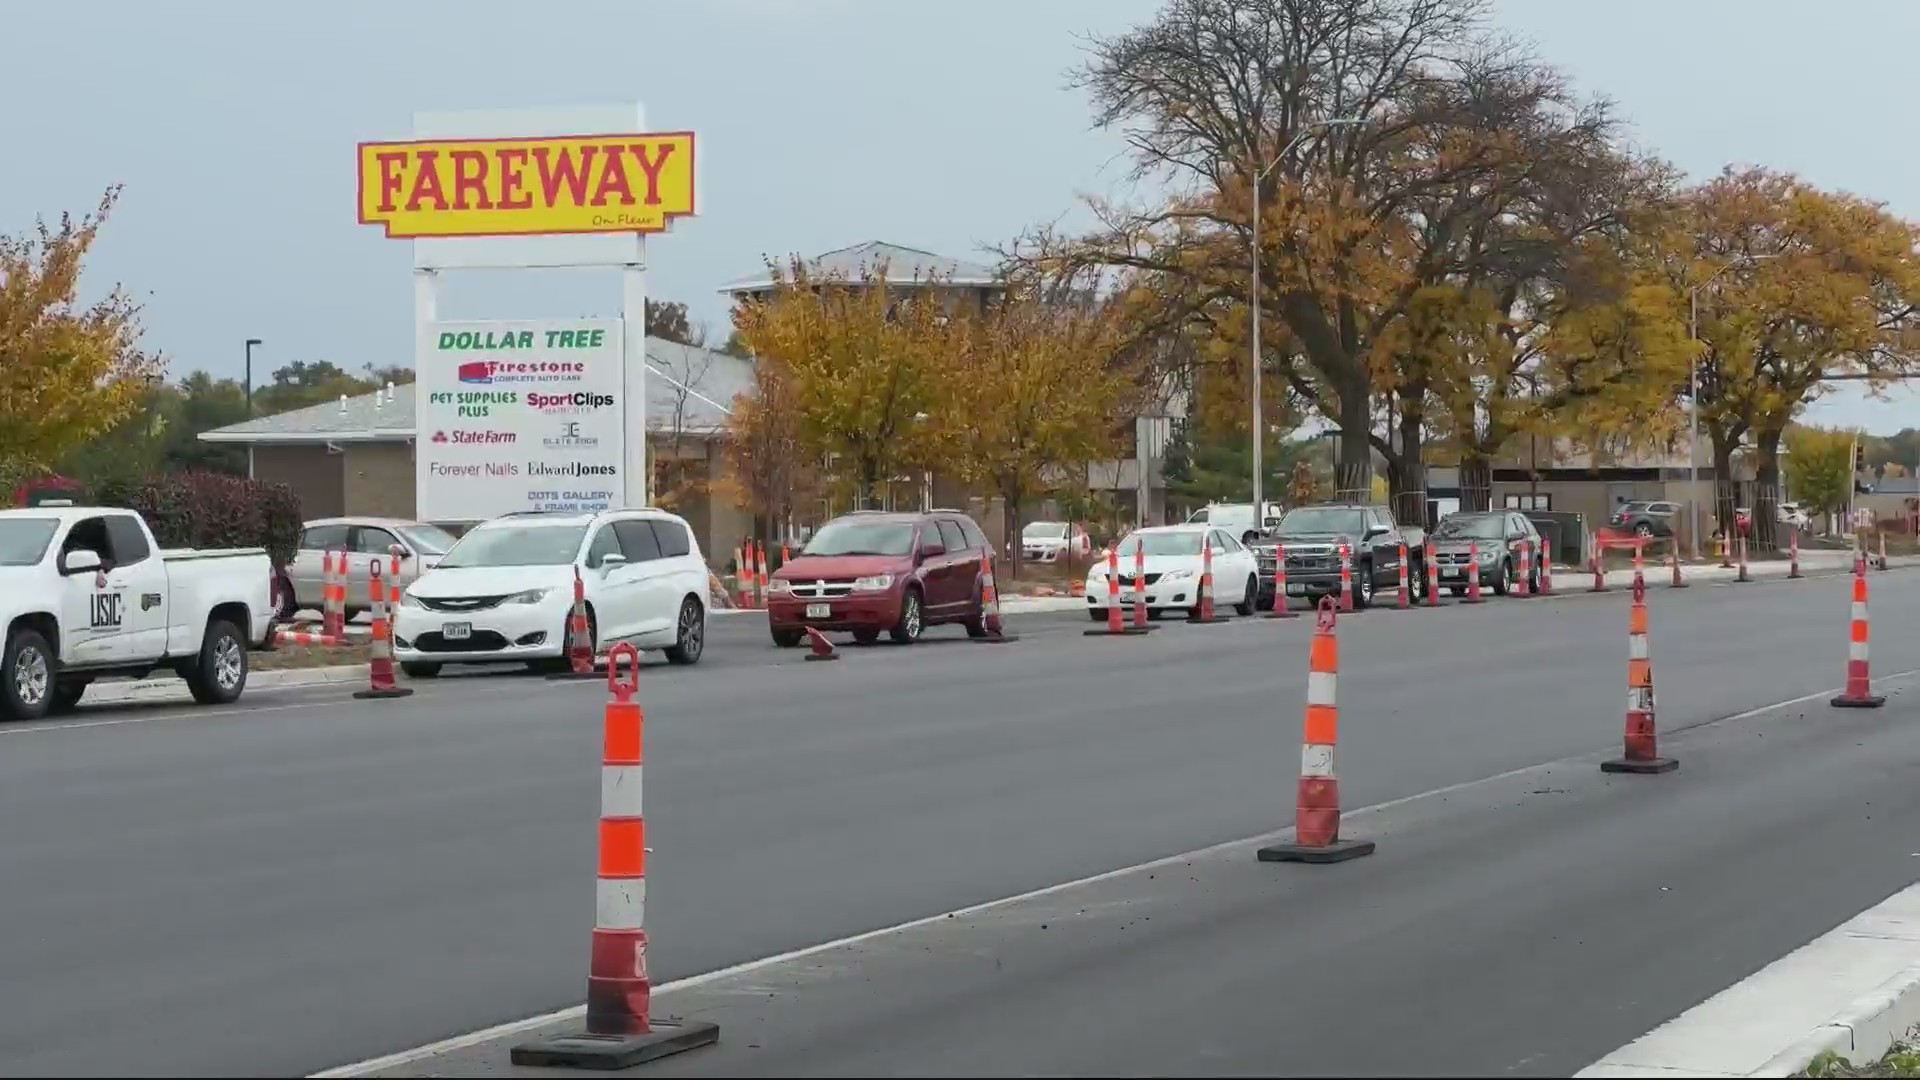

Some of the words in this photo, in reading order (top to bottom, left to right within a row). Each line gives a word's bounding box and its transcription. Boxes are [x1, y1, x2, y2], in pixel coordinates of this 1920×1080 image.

[376, 143, 675, 212] FAREWAY
[592, 215, 615, 227] On
[617, 214, 654, 226] Fleur
[438, 331, 534, 350] DOLLAR
[545, 329, 605, 348] TREE
[488, 361, 585, 375] Firestone
[430, 393, 453, 404] PET
[457, 392, 517, 404] SUPPLIES
[458, 406, 489, 417] PLUS
[430, 462, 480, 476] Forever
[485, 462, 518, 475] Nails
[563, 491, 613, 500] GALLERY
[545, 503, 576, 512] FRAME
[91, 593, 121, 626] USIC
